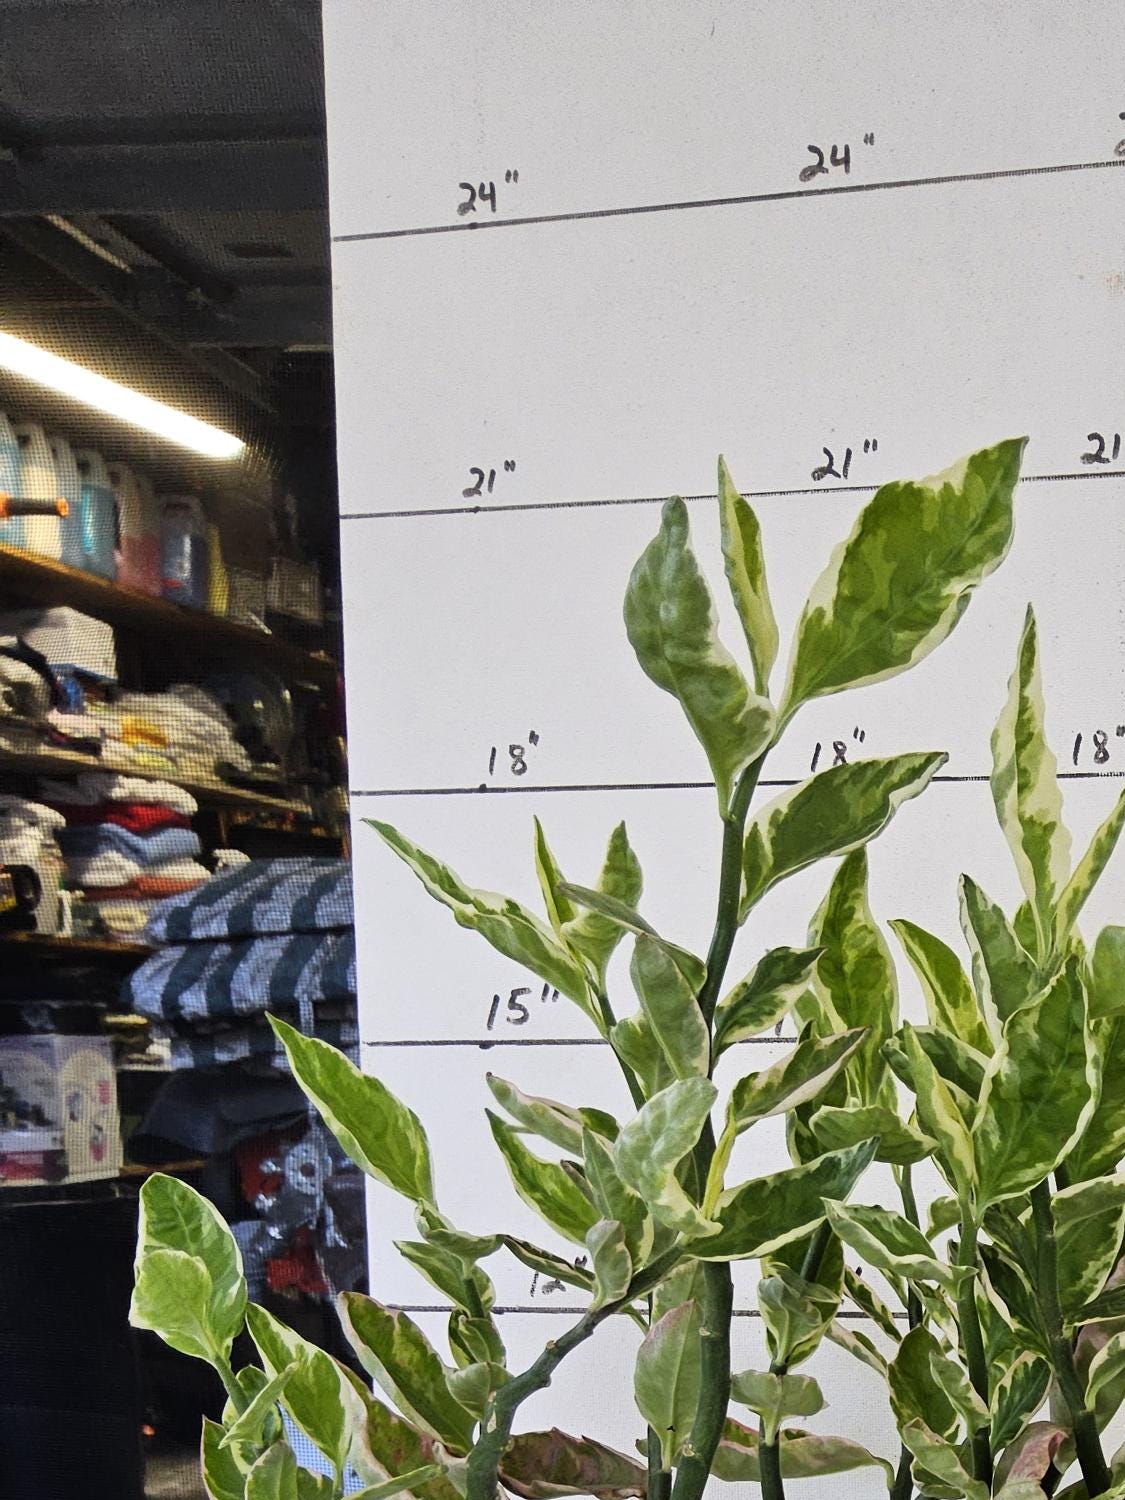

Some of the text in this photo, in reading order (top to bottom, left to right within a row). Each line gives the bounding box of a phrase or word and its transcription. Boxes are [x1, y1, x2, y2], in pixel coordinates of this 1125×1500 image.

[798, 132, 875, 183] 24"
[456, 169, 519, 216] 24"
[462, 459, 517, 498] 21"
[810, 438, 878, 482] 21"
[488, 729, 540, 777] 18"
[486, 981, 560, 1031] 15"
